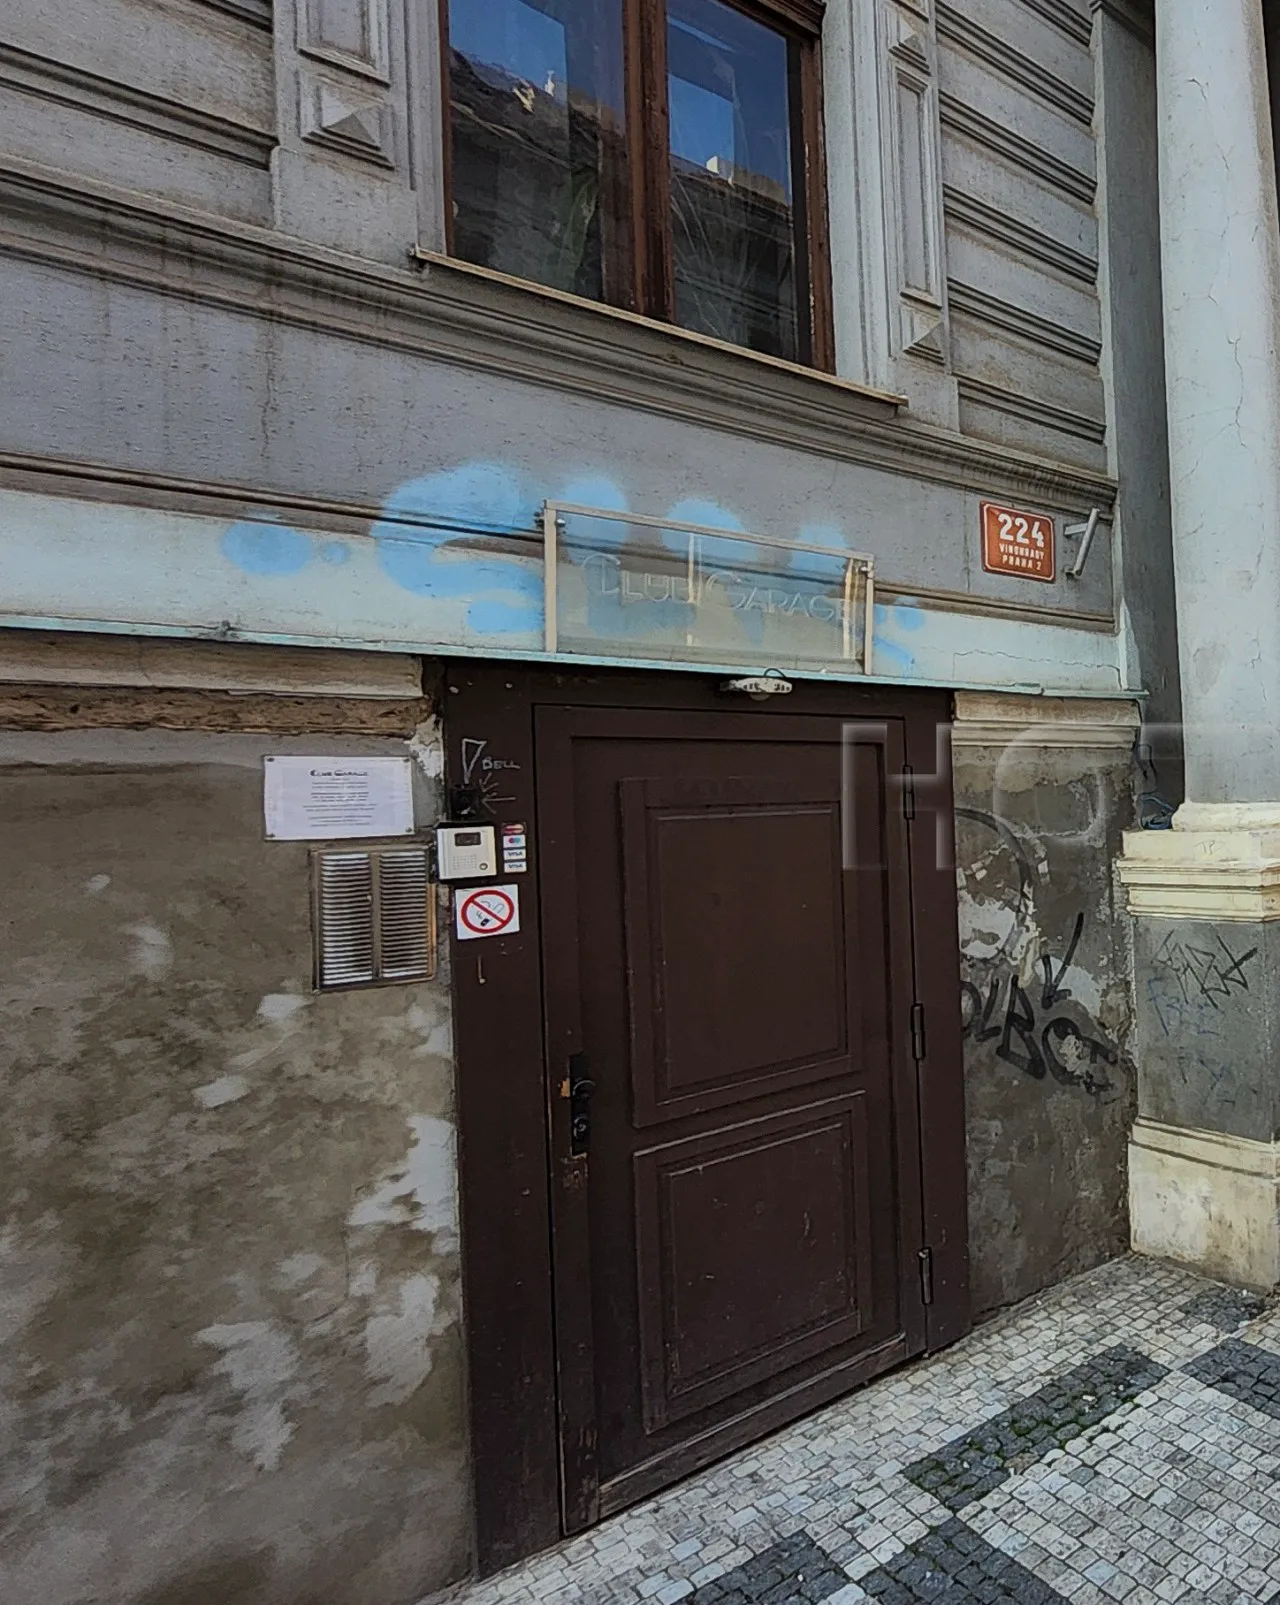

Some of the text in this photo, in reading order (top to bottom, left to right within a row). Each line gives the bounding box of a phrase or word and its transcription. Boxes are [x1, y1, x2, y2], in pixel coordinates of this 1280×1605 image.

[998, 513, 1044, 548] 224
[999, 542, 1044, 560] VINOHRADY
[1002, 555, 1042, 571] PRAHA 2
